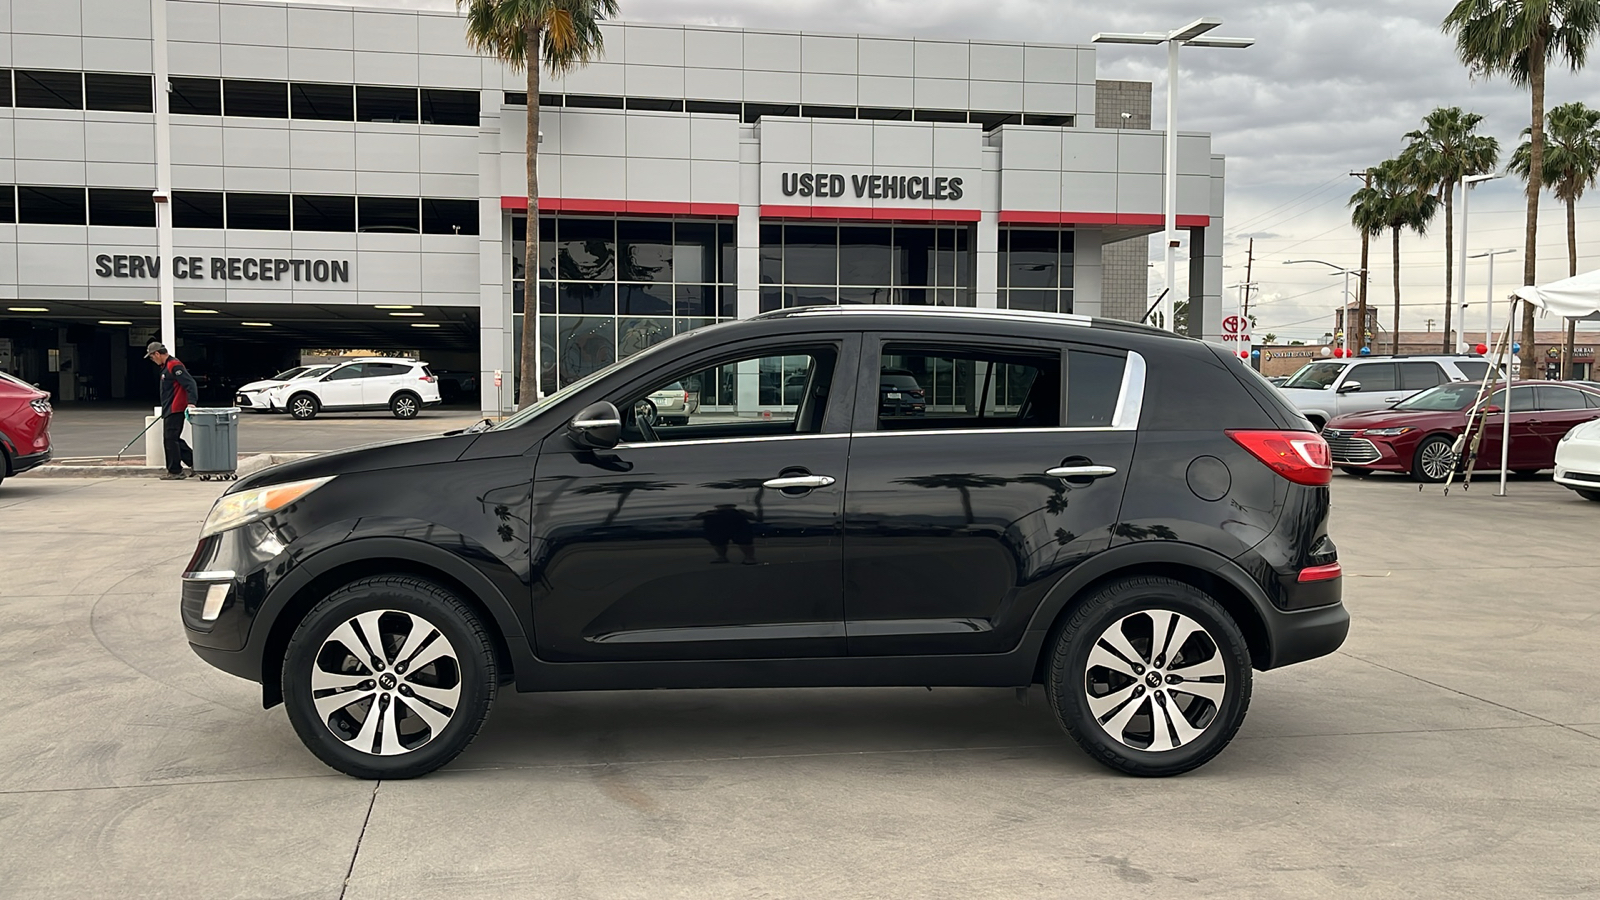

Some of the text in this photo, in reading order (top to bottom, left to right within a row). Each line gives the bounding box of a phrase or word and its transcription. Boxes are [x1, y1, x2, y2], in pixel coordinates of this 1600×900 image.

[782, 172, 964, 200] USED VEHICLES
[95, 254, 349, 283] SERVCE RECEPTION
[380, 675, 394, 688] KIA
[1147, 673, 1160, 687] KIA
